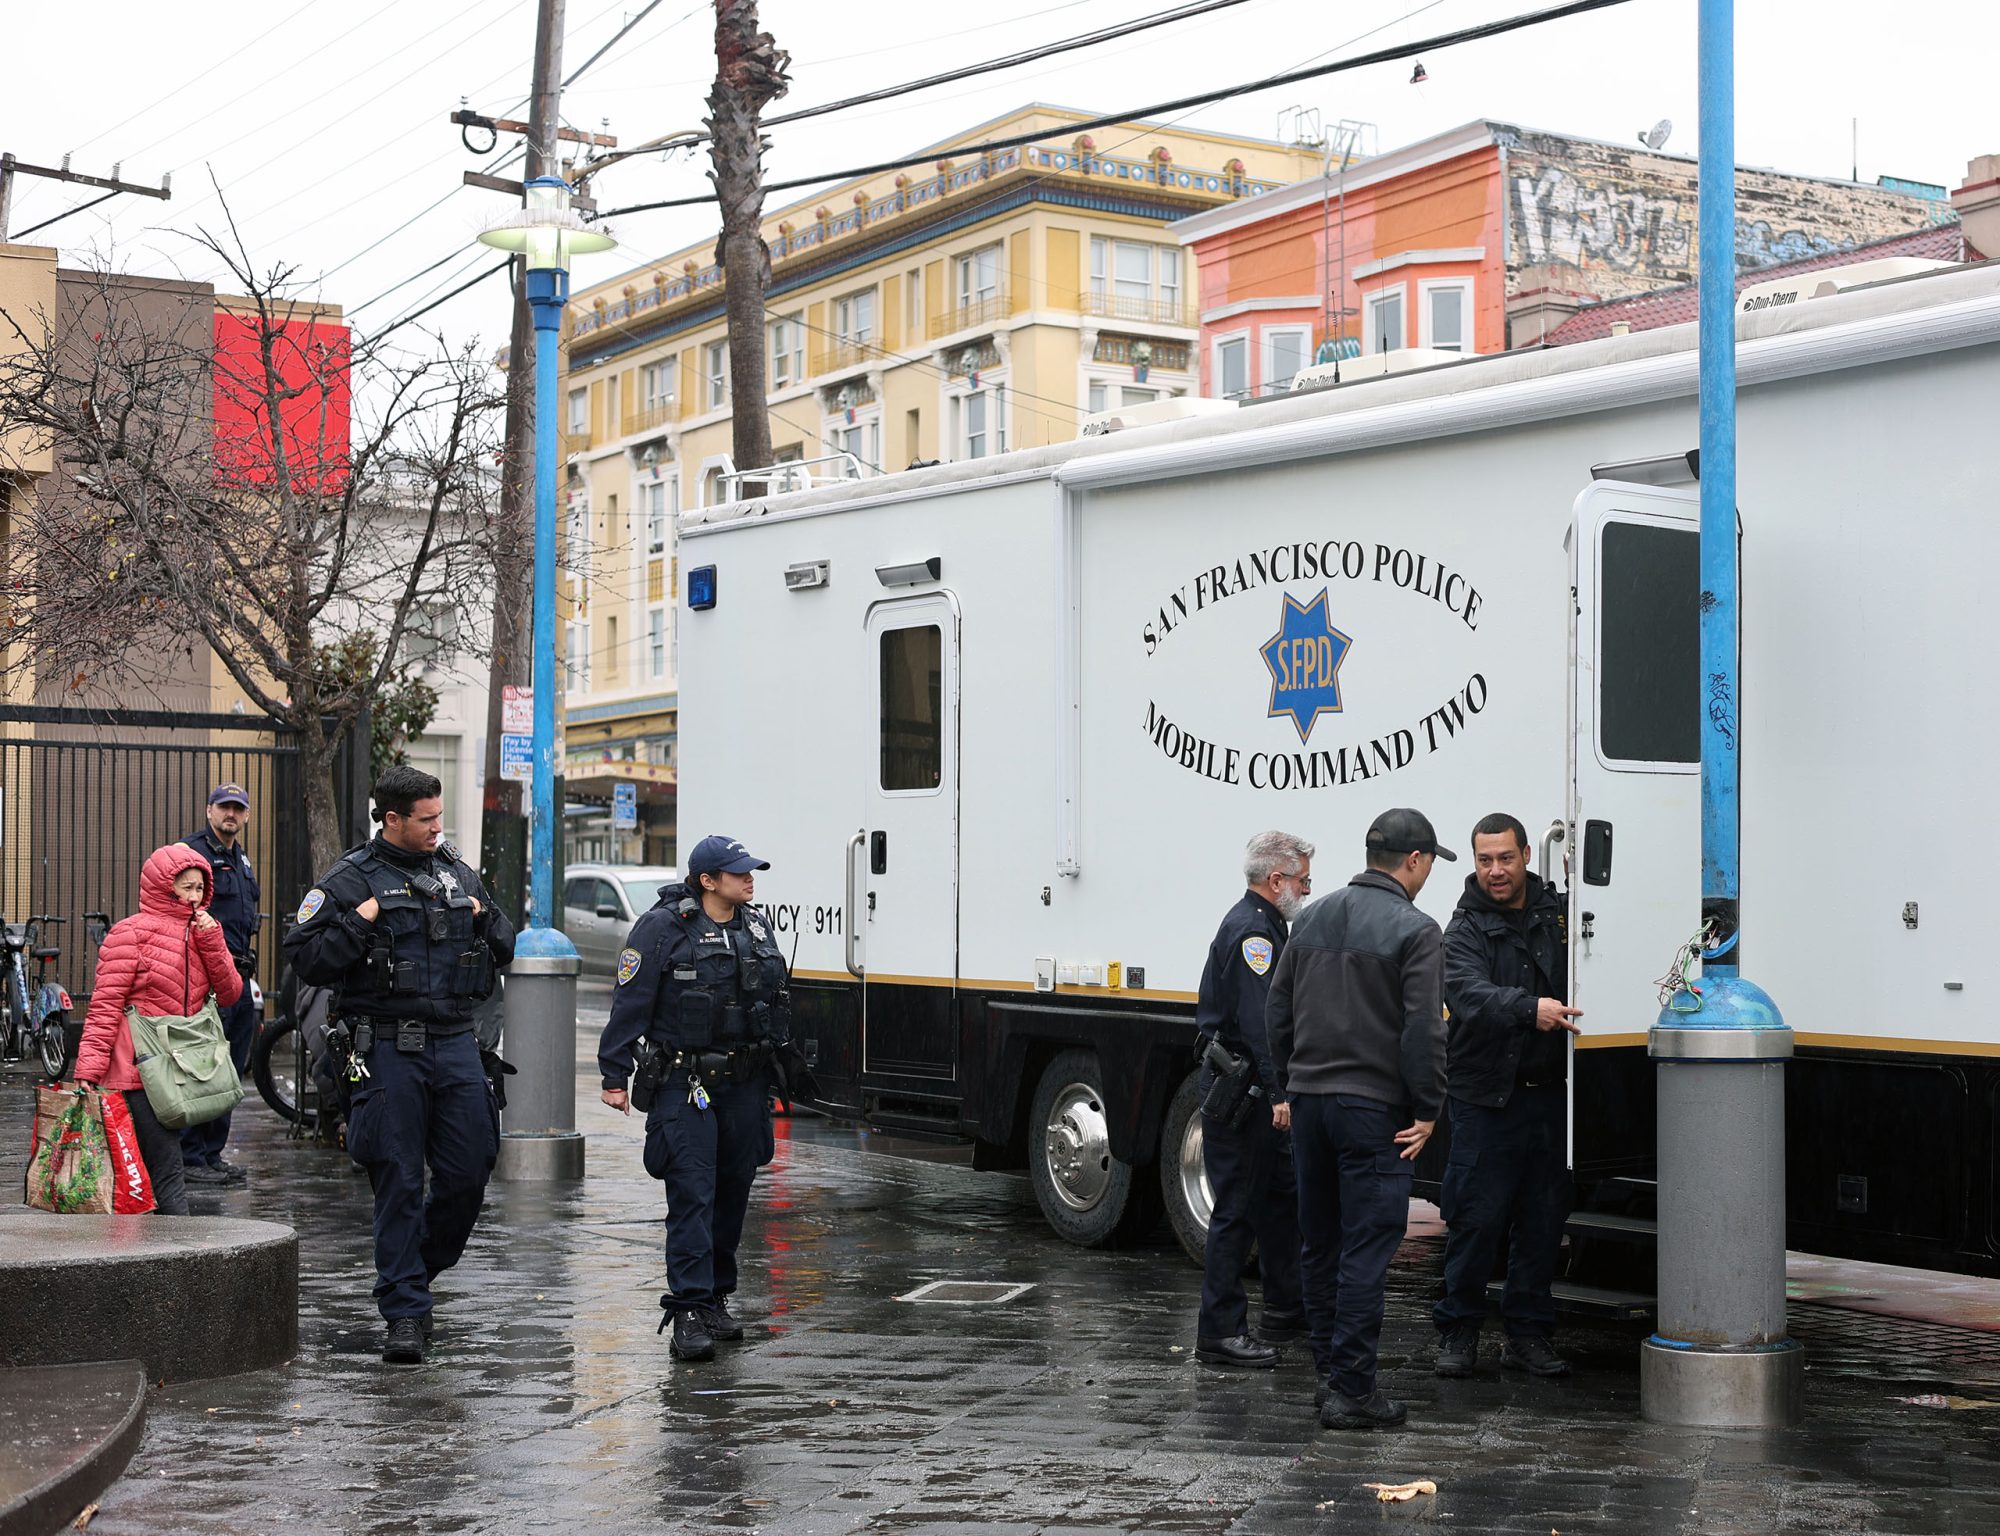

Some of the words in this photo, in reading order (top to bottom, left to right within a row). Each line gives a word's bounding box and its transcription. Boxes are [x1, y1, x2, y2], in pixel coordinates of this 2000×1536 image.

[1753, 291, 1798, 310] Duo-Therm
[1143, 586, 1188, 658] SAN
[1194, 540, 1364, 613] FRANCISCO
[1372, 543, 1483, 632] POLICE
[1142, 699, 1241, 786] MOBILE
[1248, 728, 1415, 791] COMMAND
[1419, 673, 1488, 754] TWO
[504, 746, 534, 755] License
[505, 736, 519, 747] Pay
[521, 736, 532, 748] by
[504, 753, 526, 762] Plate
[815, 906, 842, 935] 911
